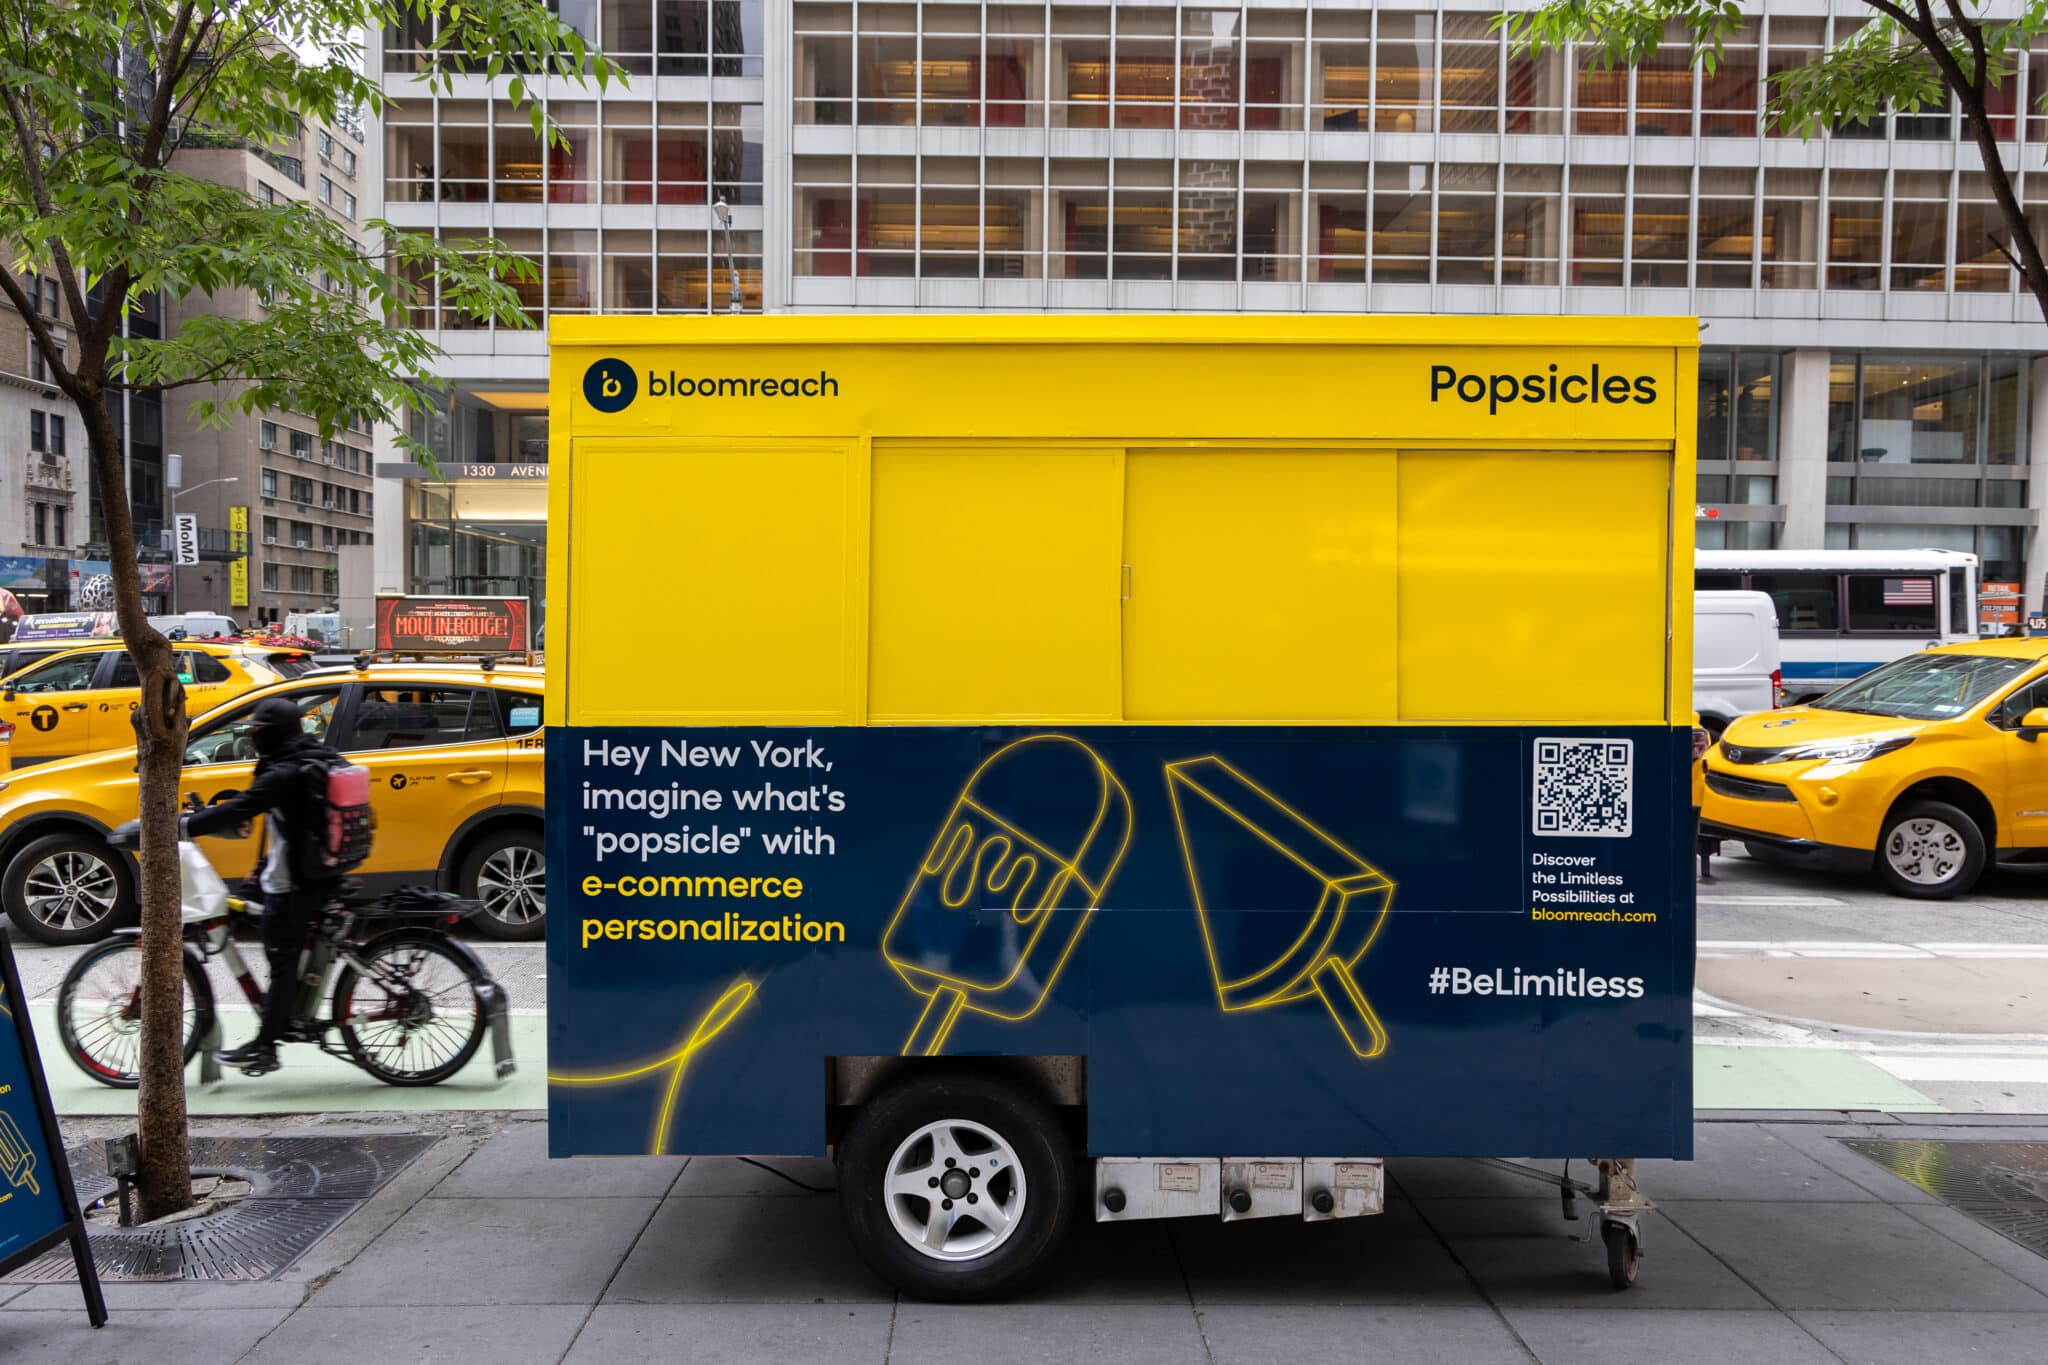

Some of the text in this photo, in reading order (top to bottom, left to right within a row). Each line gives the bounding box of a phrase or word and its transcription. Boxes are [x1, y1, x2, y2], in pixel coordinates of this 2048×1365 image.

[649, 371, 839, 397] bloomreach
[1431, 364, 1657, 415] Popsicles
[463, 465, 549, 477] 1330 AVEN
[180, 518, 195, 563] MoMA
[395, 615, 509, 637] MOULIN ROUGE!
[583, 739, 833, 775] Hey New York,
[583, 781, 846, 819] imagine what's
[583, 825, 836, 862] "popsicle" with
[1532, 853, 1597, 866] Discover
[582, 875, 803, 898] e-commerce
[1532, 871, 1624, 885] the Limitless
[1532, 890, 1635, 903] Possibilities at
[1532, 907, 1657, 923] bloomreach.com
[582, 912, 845, 948] personalization
[1428, 966, 1645, 998] #BeLimitless
